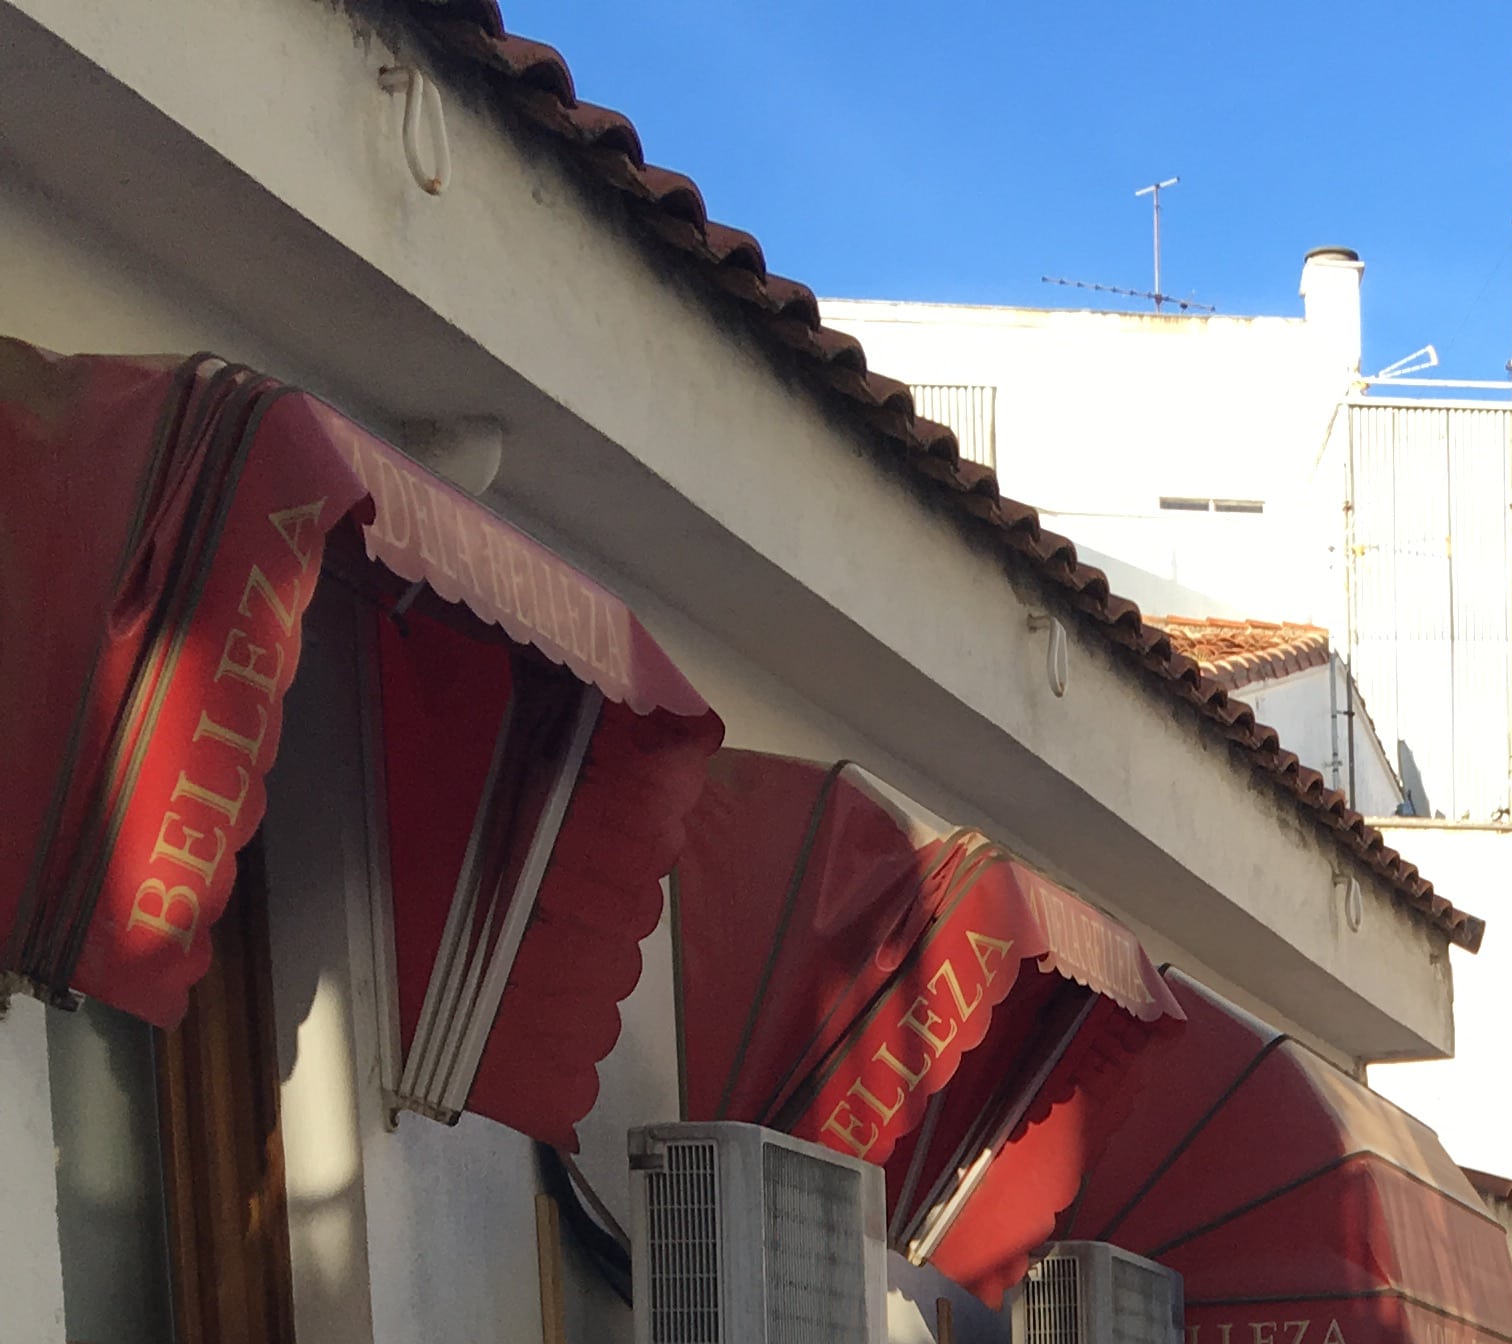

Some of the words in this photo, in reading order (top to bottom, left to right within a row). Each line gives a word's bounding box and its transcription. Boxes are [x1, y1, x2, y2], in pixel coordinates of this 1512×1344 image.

[480, 518, 634, 688] BELLEZA
[126, 494, 328, 954] BELLEZA
[820, 928, 1015, 1160] ELLEZA
